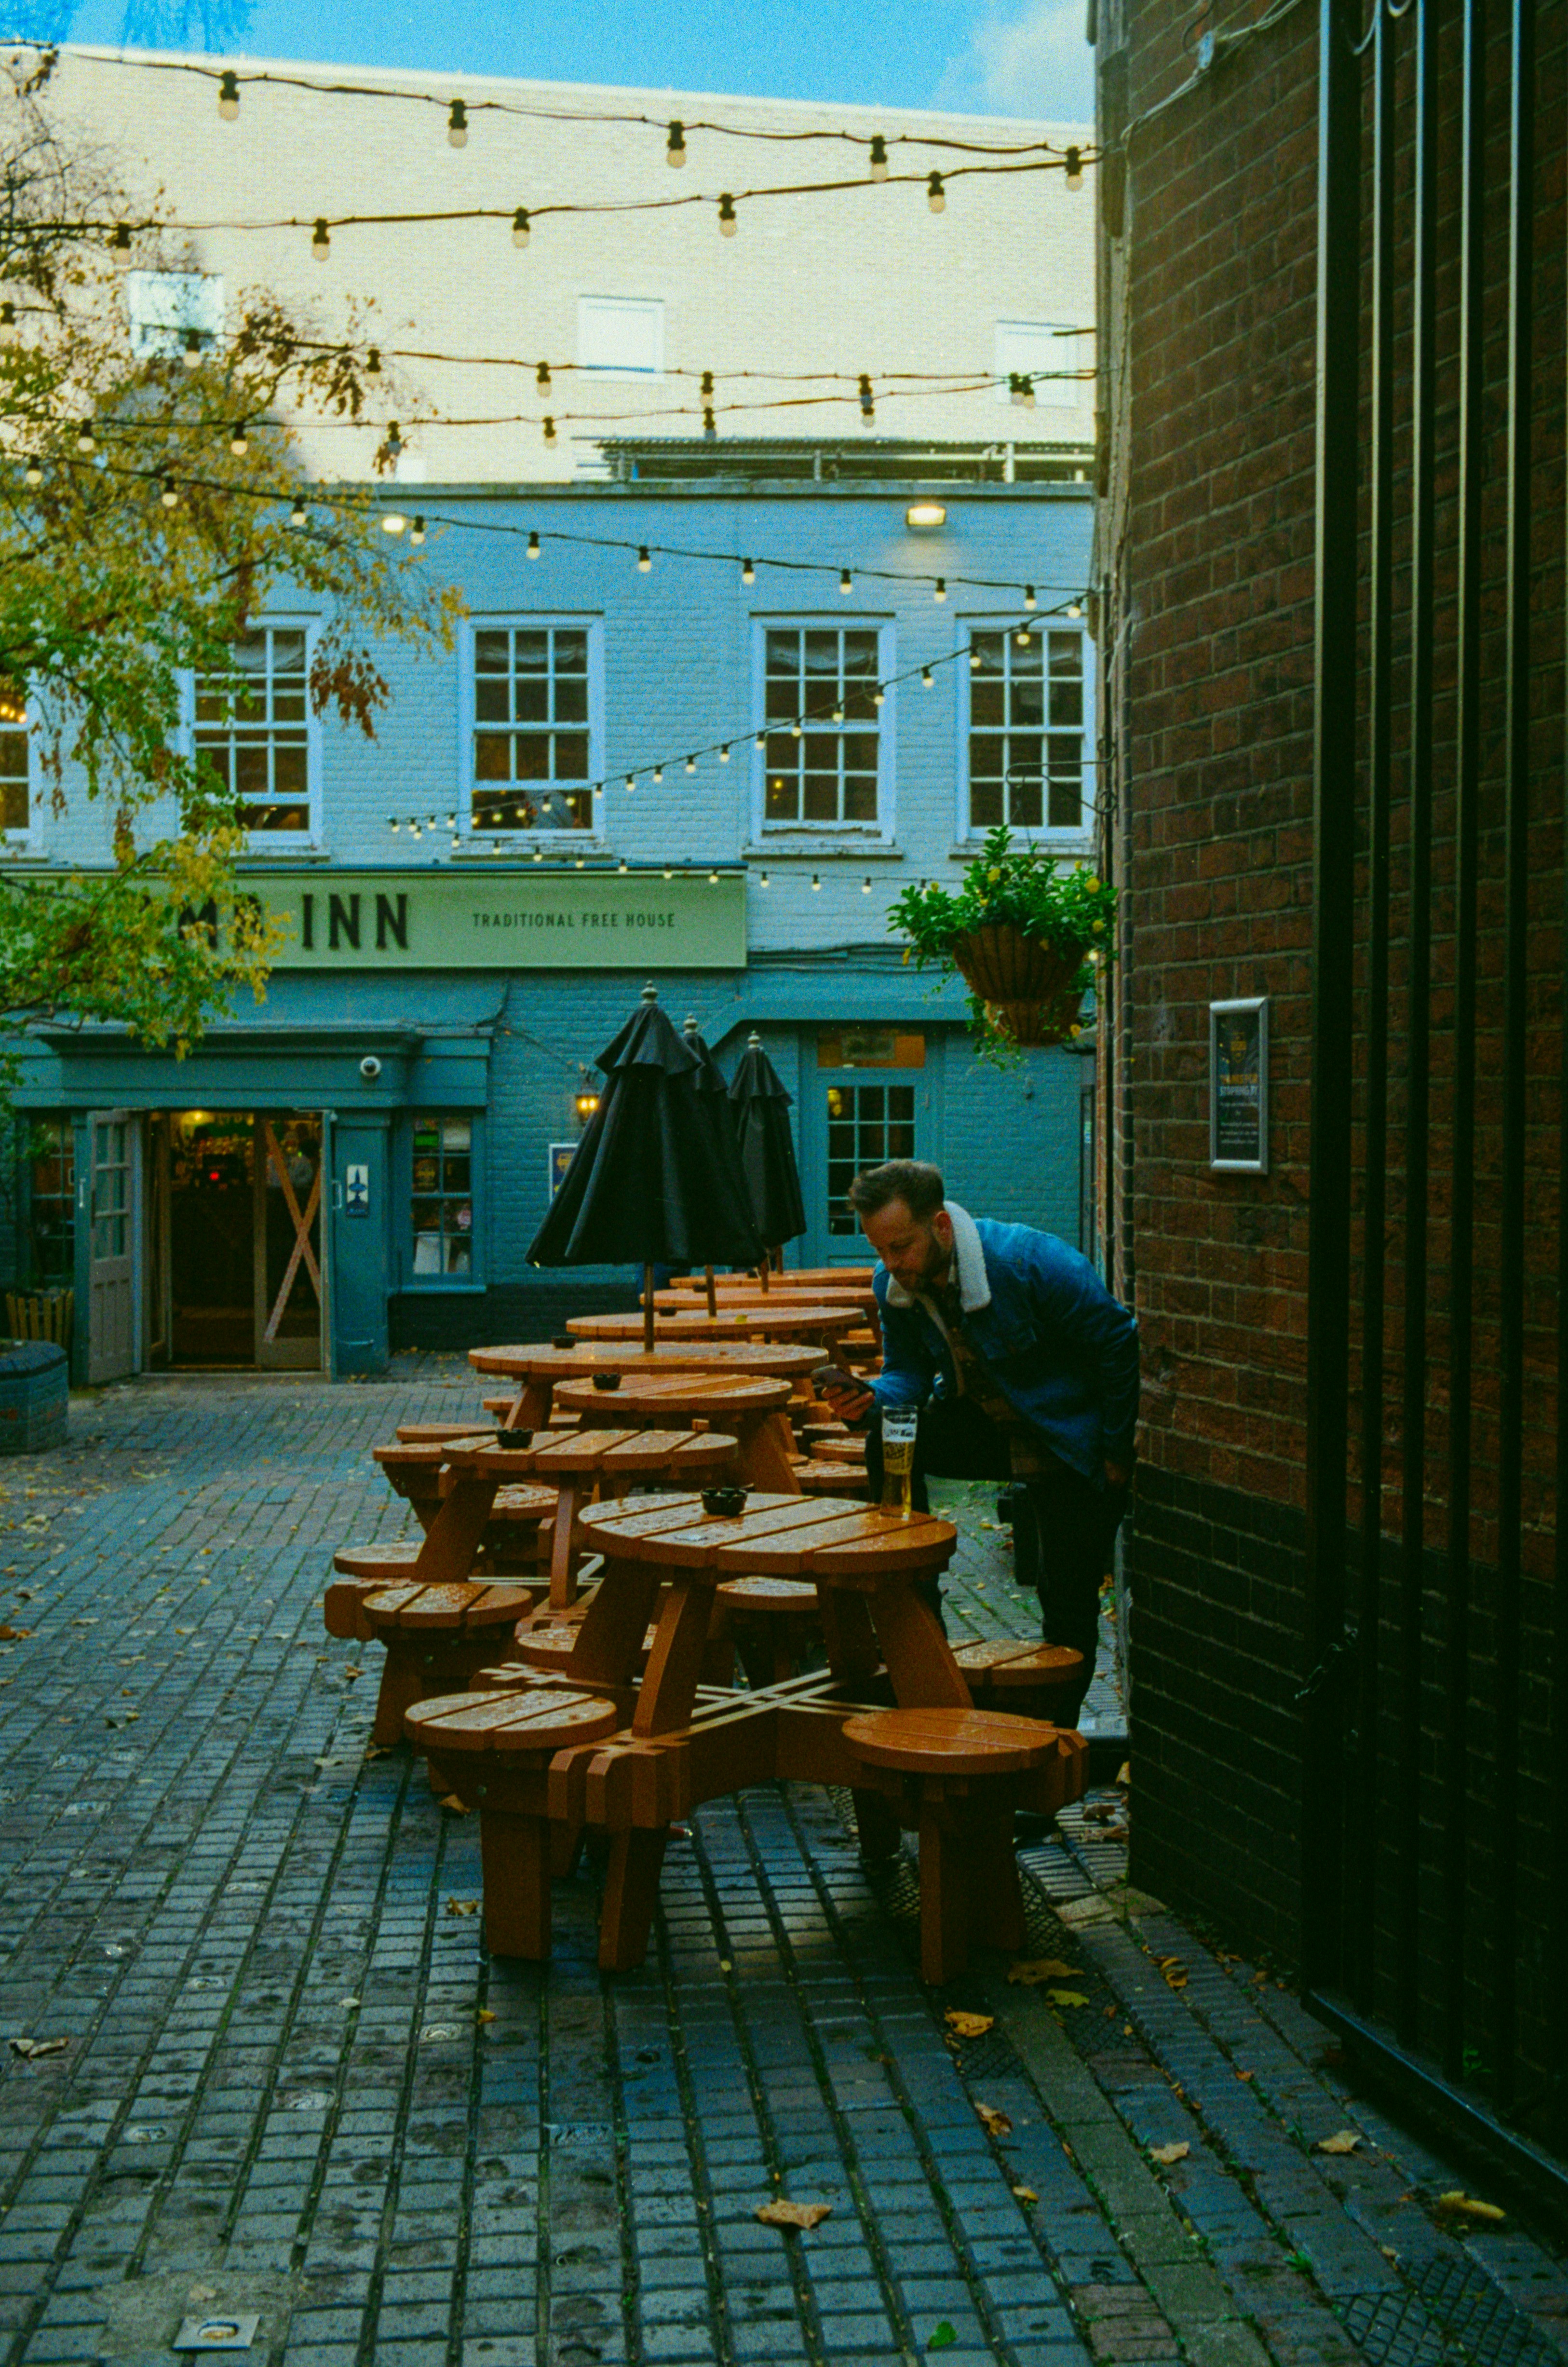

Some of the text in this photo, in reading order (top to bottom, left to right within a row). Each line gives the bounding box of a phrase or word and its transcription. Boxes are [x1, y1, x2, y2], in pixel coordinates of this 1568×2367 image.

[302, 894, 409, 950] INN
[473, 913, 675, 927] TRADITIONAL FREE HOUSE
